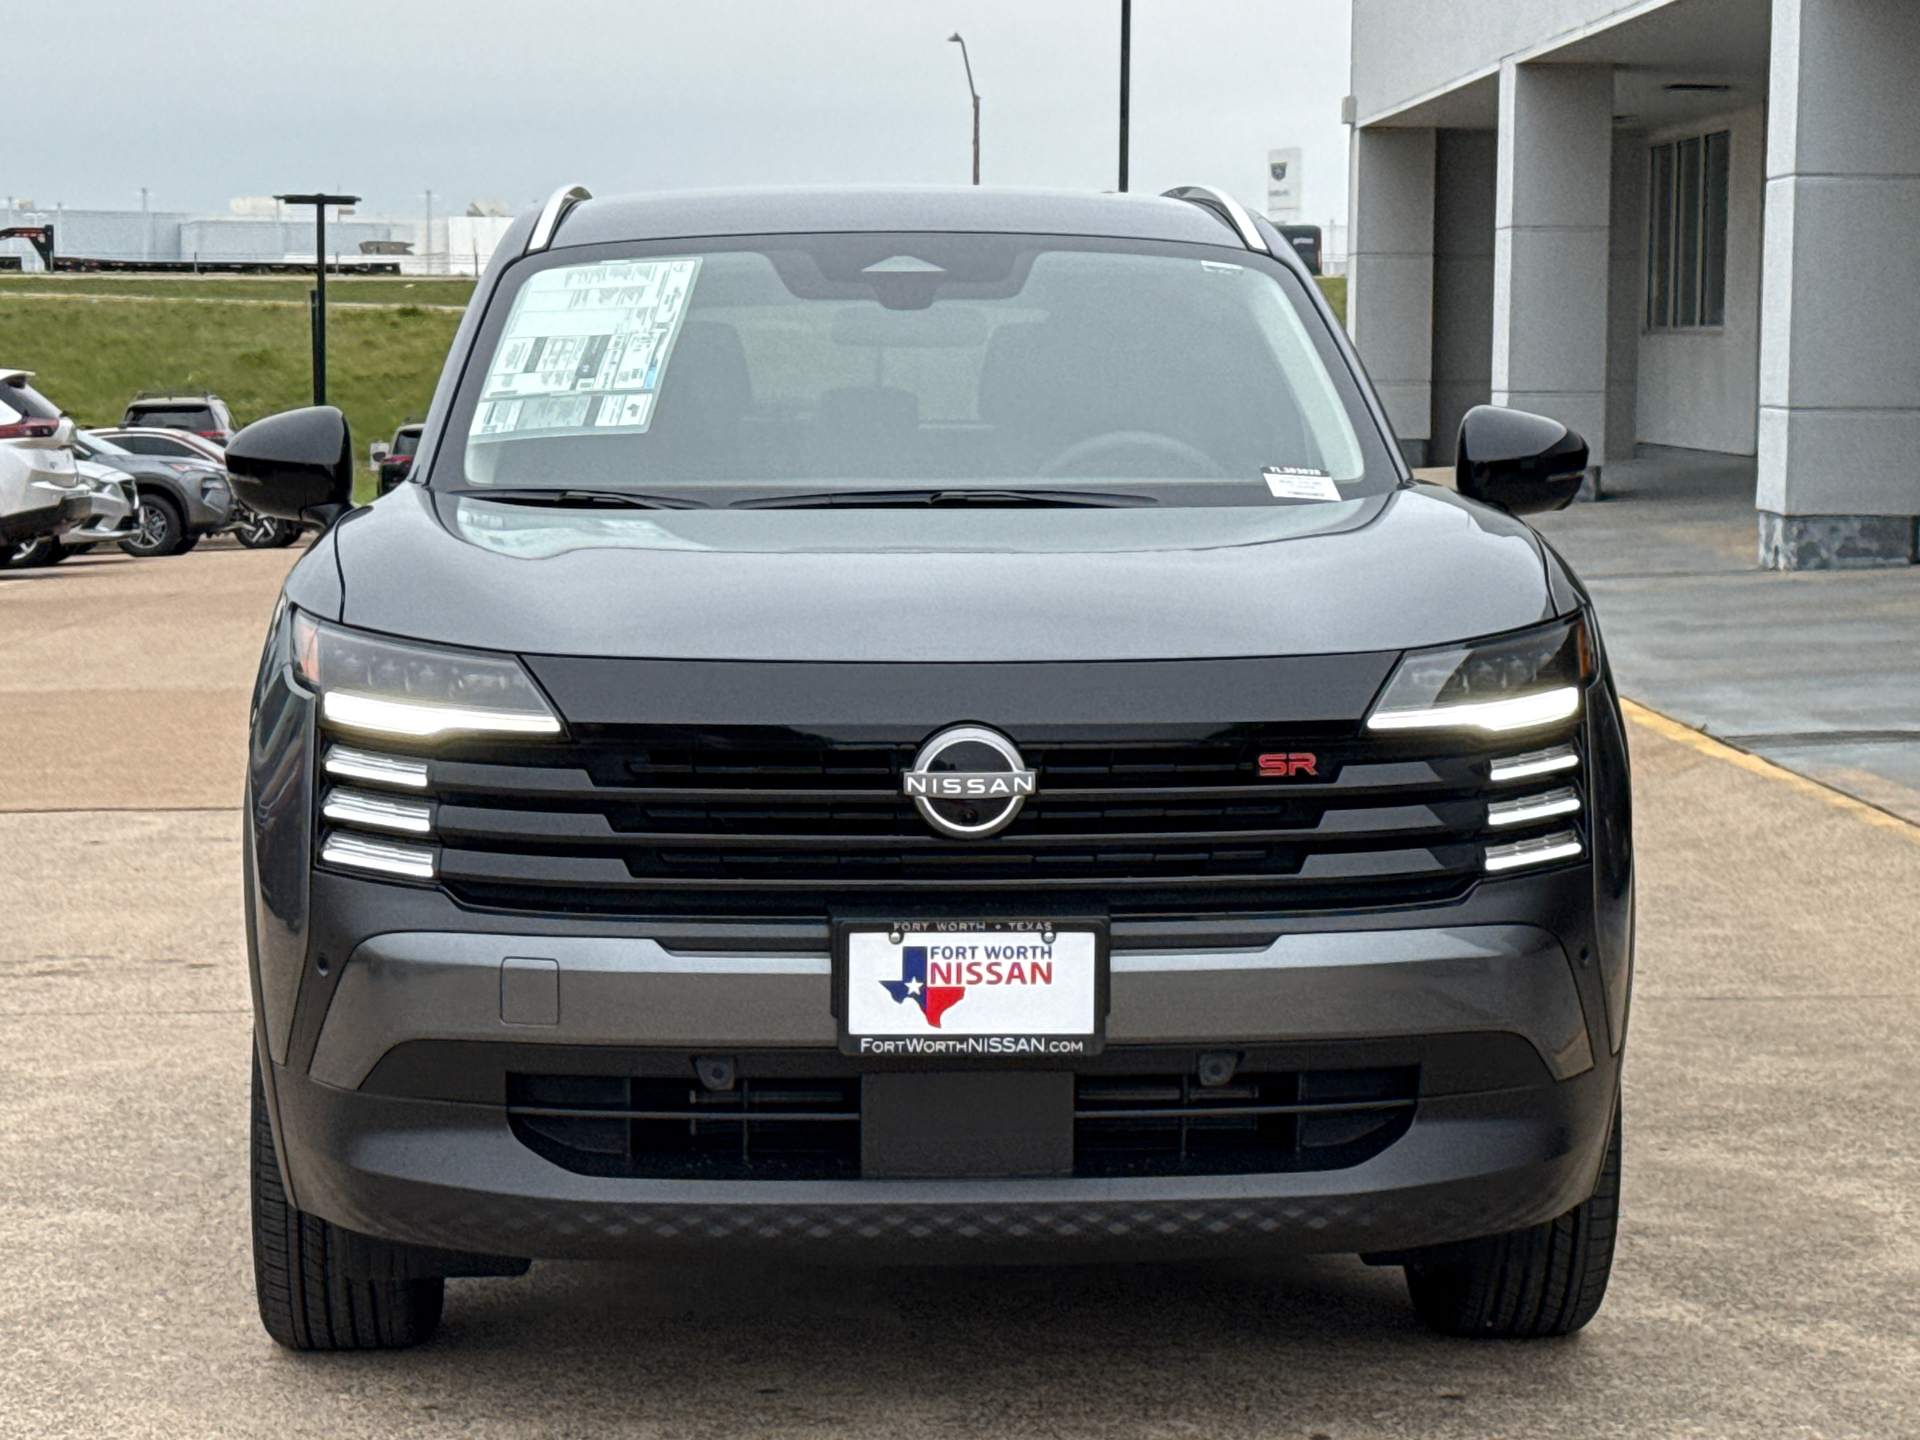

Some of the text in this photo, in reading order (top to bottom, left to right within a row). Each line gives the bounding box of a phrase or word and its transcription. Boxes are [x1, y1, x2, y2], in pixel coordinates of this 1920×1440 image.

[1258, 752, 1318, 776] SR
[907, 775, 1033, 795] NISSAN
[893, 921, 1053, 932] FORT WORTH TEXAS
[930, 945, 1053, 960] FORT WORTH
[930, 961, 1053, 985] NISSAN
